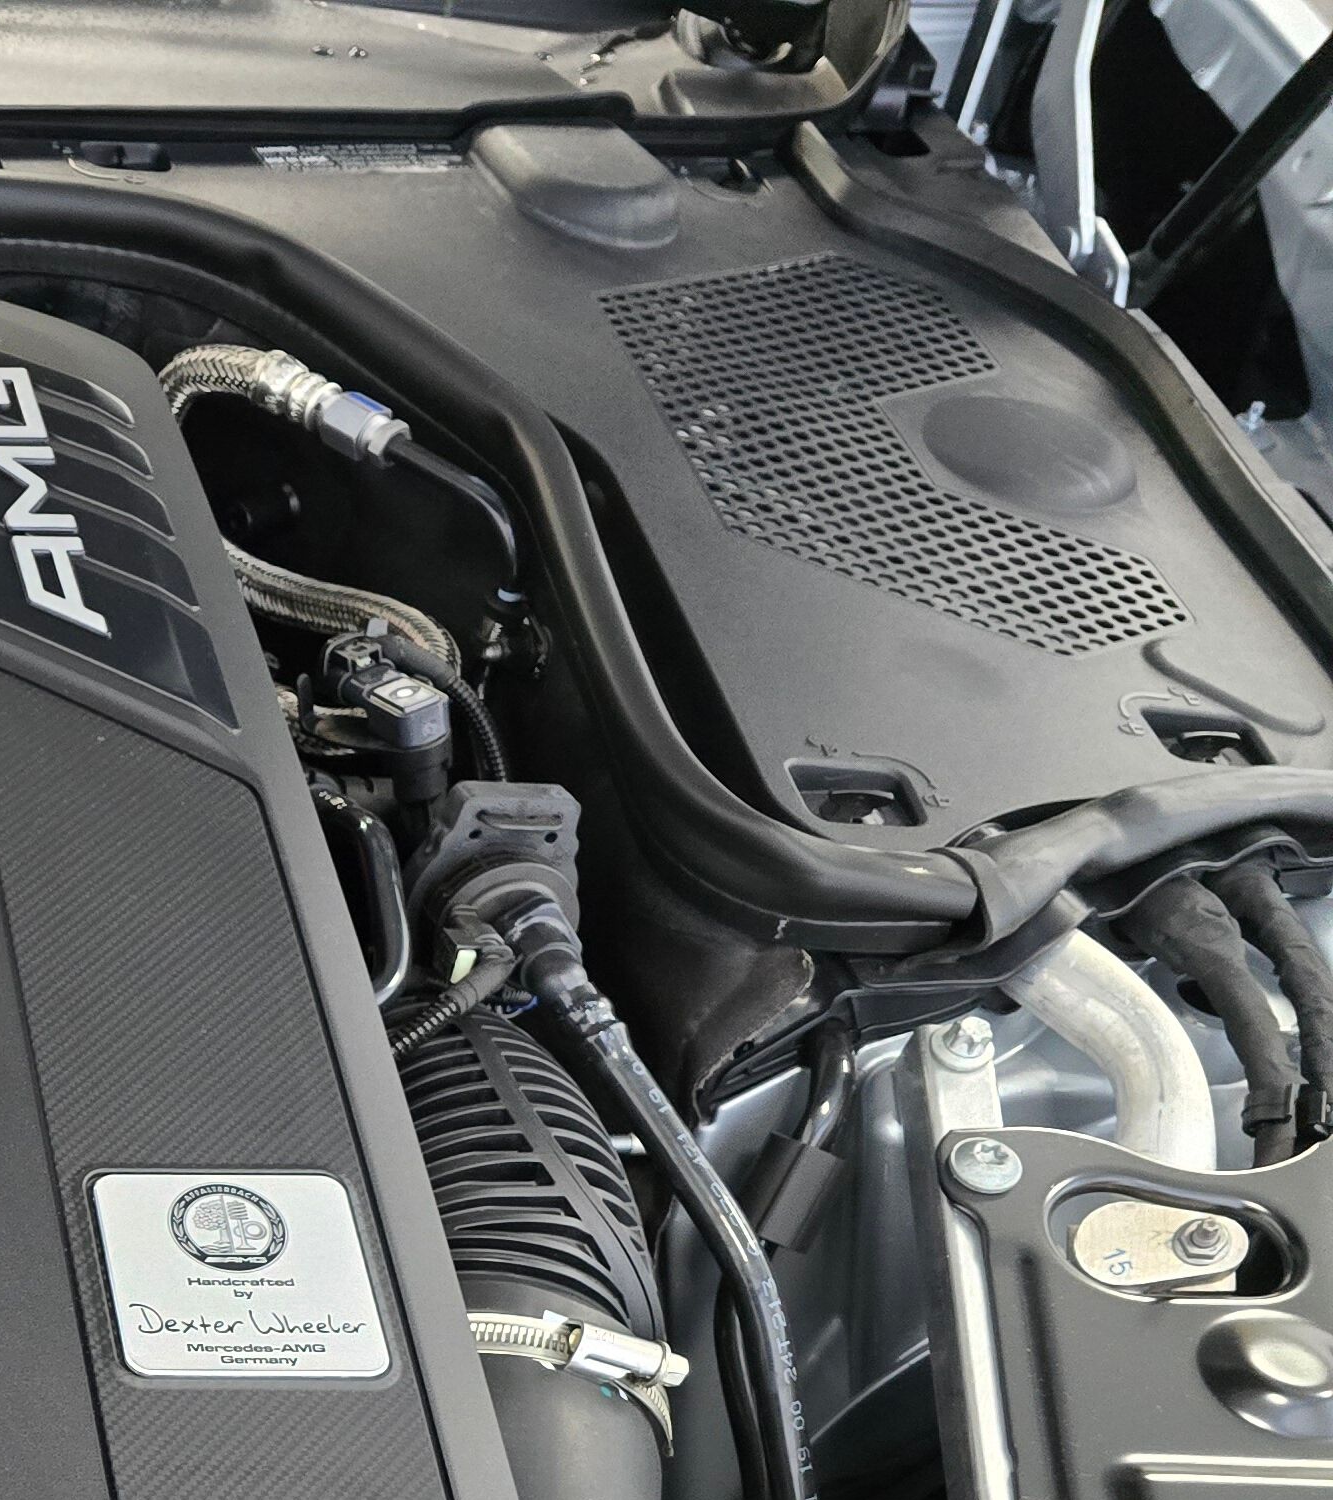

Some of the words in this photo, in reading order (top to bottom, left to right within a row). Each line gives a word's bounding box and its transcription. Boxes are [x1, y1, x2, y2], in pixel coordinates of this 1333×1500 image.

[184, 1184, 259, 1203] AFFALTERBACH
[187, 1277, 295, 1287] Handcrafted
[233, 1289, 254, 1300] by
[128, 1303, 244, 1335] Dexter
[248, 1309, 367, 1335] Wheeler
[186, 1343, 326, 1354] Mercedes-AMG
[220, 1355, 298, 1366] Germany
[791, 1400, 805, 1431] 00
[797, 1446, 813, 1474] 19
